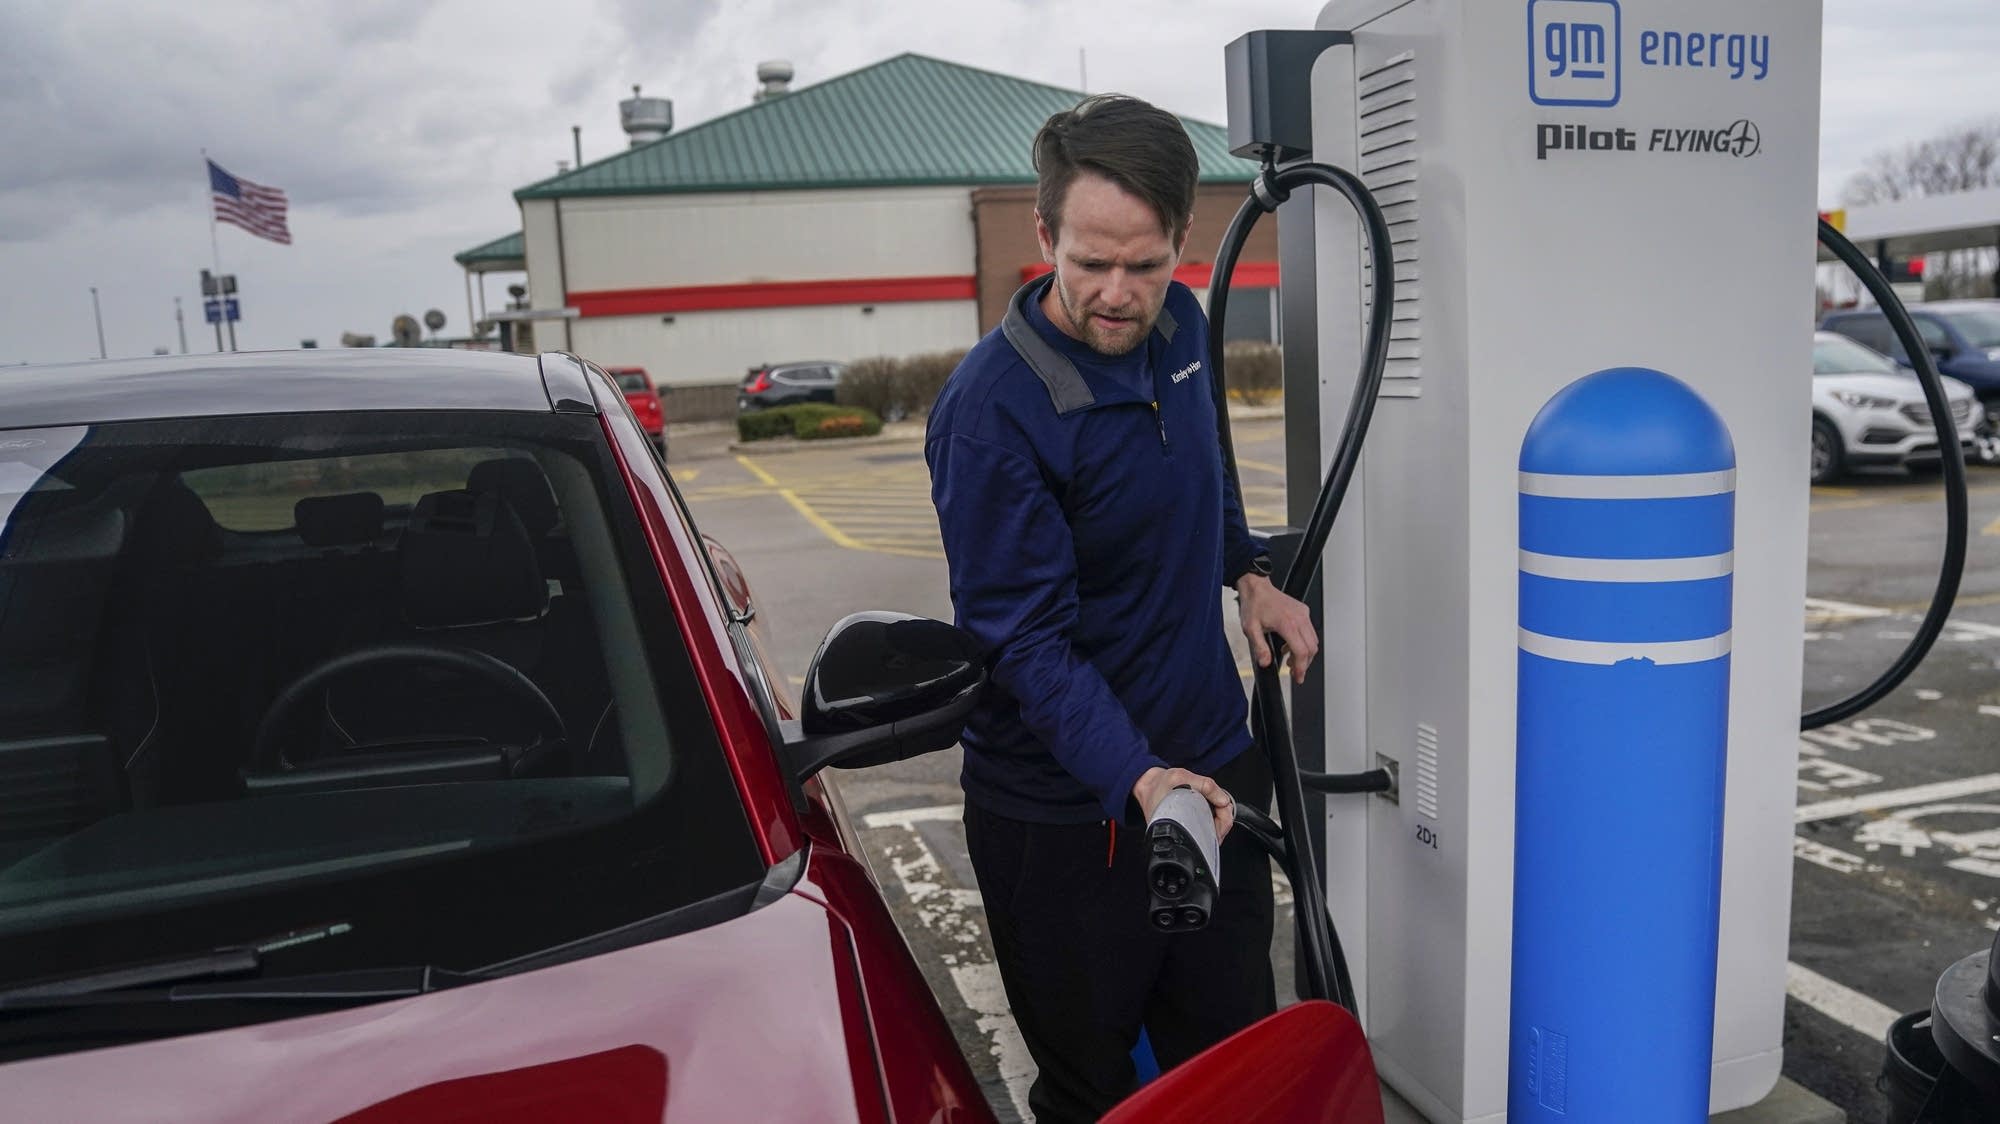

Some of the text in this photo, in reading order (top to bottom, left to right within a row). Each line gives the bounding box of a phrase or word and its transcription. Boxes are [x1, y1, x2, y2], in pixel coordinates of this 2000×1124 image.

[1640, 30, 1769, 80] energy
[1648, 129, 1731, 153] FLYING
[1416, 824, 1438, 849] 2D1
